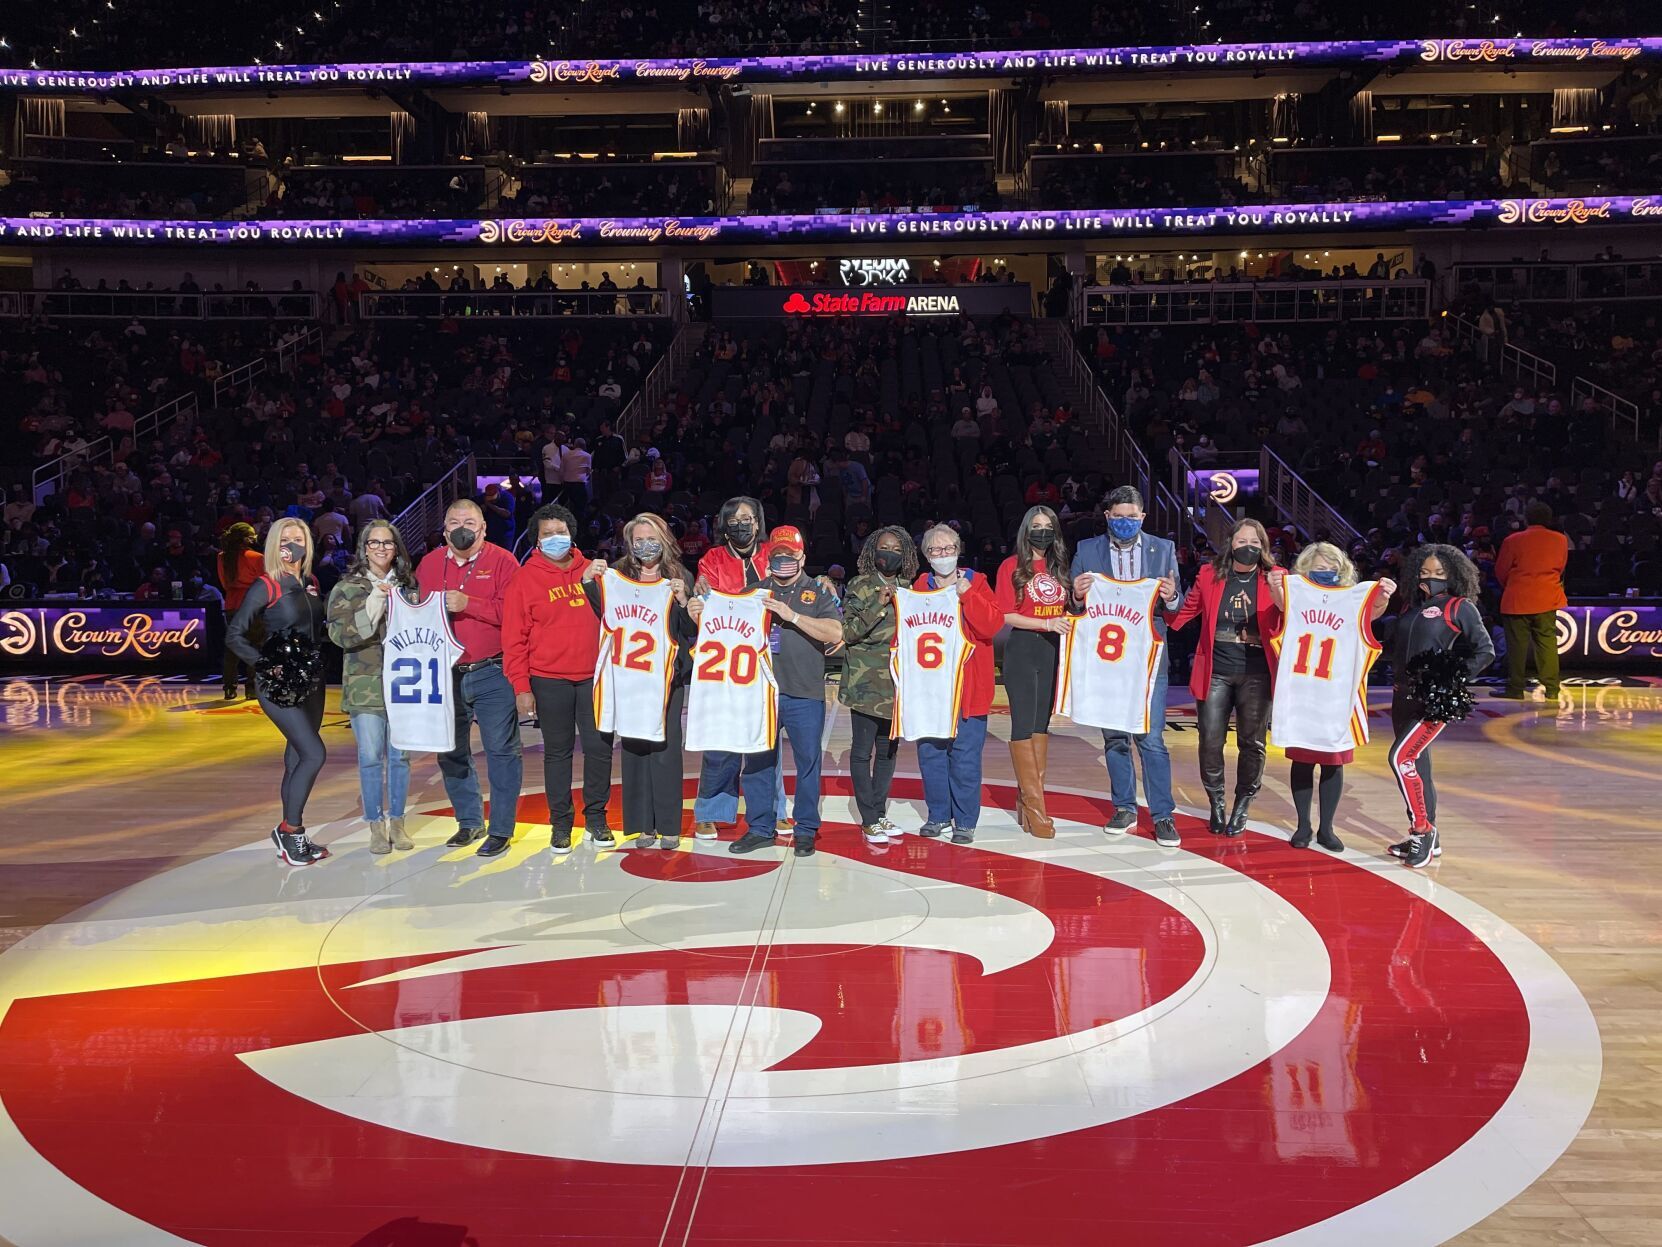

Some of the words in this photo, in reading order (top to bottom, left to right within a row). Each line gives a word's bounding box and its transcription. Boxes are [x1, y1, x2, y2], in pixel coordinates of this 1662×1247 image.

[856, 61, 888, 72] LIVE
[897, 58, 996, 71] GENEROUSLY
[1003, 57, 1036, 68] AND
[1044, 55, 1076, 67] LIFE
[1085, 54, 1122, 65] WILL
[1130, 52, 1177, 64] TREAT
[1186, 51, 1217, 62] YOU
[1226, 49, 1295, 61] ROYALLY
[1446, 42, 1480, 60] Crown
[1531, 41, 1589, 60] Crowning
[1591, 40, 1641, 59] Courage
[0, 75, 28, 86] IVE
[37, 76, 134, 87] GENEROUSLY
[141, 75, 170, 86] AND
[178, 73, 208, 85] LIFE
[215, 72, 250, 83] WILL
[258, 71, 301, 82] TREAT
[309, 70, 339, 81] YOU
[347, 69, 411, 80] ROYALLY
[555, 62, 587, 82] Crown
[635, 62, 691, 80] Crowning
[692, 61, 740, 79] Courage
[850, 221, 887, 233] LIVE
[897, 219, 1009, 232] GENEROUSLY
[1019, 218, 1055, 230] AND
[1065, 217, 1101, 229] LIFE
[1112, 216, 1153, 228] WILL
[1164, 214, 1217, 227] TREAT
[1227, 213, 1262, 225] YOU
[1273, 210, 1352, 224] ROYALLY
[1528, 200, 1567, 223] Crown
[17, 225, 55, 237] AND
[65, 226, 102, 238] LIFE
[112, 226, 155, 238] WILL
[165, 227, 217, 239] TREAT
[227, 227, 260, 239] YOU
[271, 227, 344, 239] ROYALLY
[507, 220, 543, 242] Crown
[600, 220, 662, 241] Crowning
[663, 220, 718, 241] Courage
[812, 292, 859, 312] State
[860, 292, 905, 312] Farm
[906, 296, 960, 311] ARENA
[614, 604, 658, 626] HUNTER
[904, 611, 955, 629] WILLIAMS
[1033, 605, 1063, 617] HAWKS
[1087, 603, 1144, 626] GALLINARI
[1301, 609, 1345, 631] YOUNG
[53, 611, 122, 654] Crown
[704, 615, 756, 639] COLLINS
[388, 627, 445, 652] WILKINS
[611, 626, 657, 673] 12
[916, 631, 945, 670] 6
[1096, 623, 1128, 663] 8
[697, 640, 759, 686] 20
[1292, 631, 1337, 681] 11
[390, 657, 443, 705] 21
